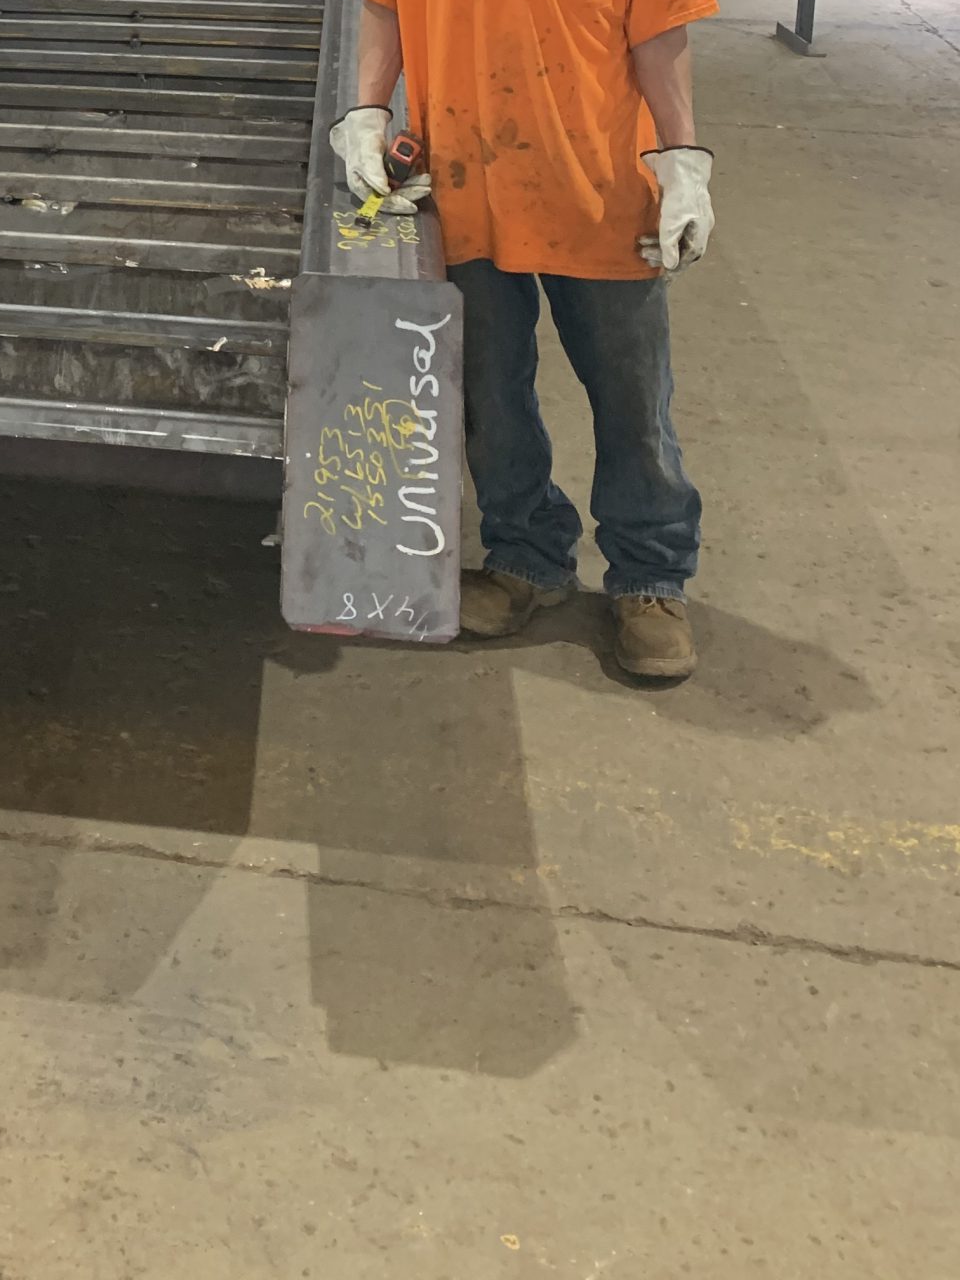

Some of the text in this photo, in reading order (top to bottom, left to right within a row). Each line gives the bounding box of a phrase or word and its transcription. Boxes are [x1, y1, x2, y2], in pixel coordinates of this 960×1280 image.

[303, 427, 344, 536] 21953
[395, 313, 452, 556] Universal
[336, 592, 357, 620] 8
